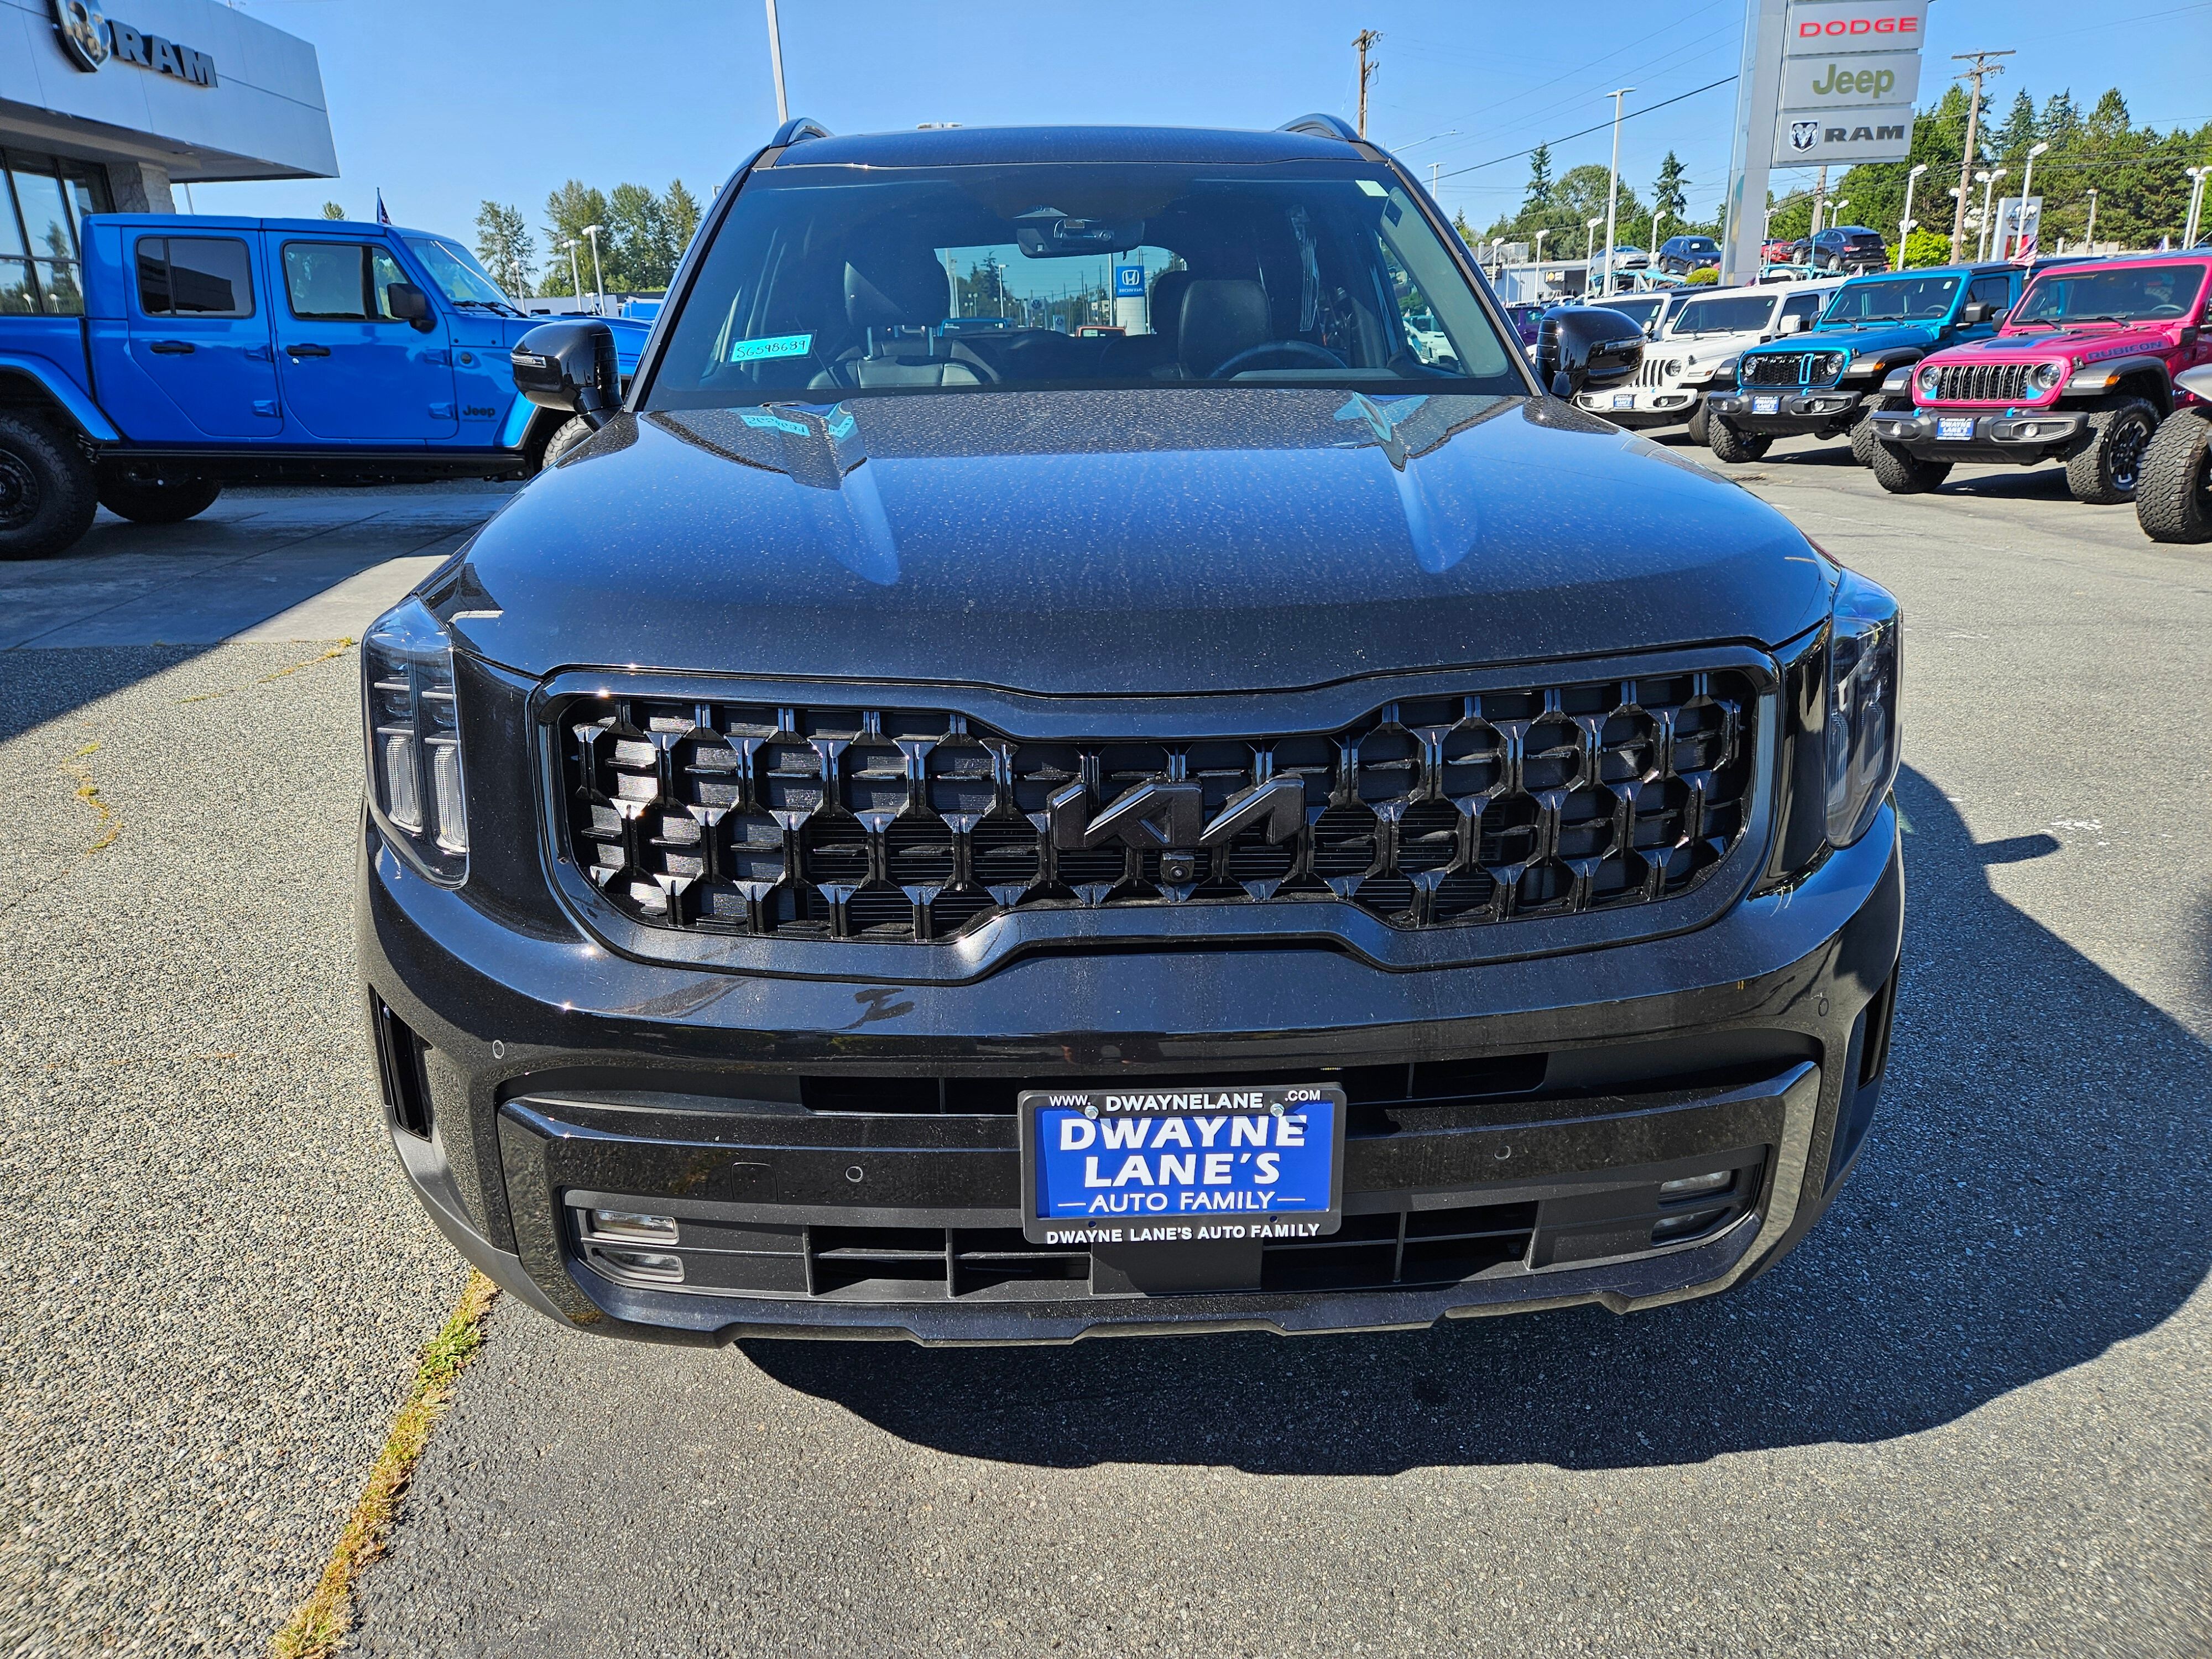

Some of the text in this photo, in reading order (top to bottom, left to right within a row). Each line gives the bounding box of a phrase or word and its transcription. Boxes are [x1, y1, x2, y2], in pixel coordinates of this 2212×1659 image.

[1799, 17, 1918, 38] DODGE
[109, 18, 218, 88] RAM
[1812, 64, 1895, 98] Jeep
[1824, 125, 1905, 143] RAM
[2087, 341, 2164, 361] RUBICON
[463, 405, 495, 418] Jeep
[1106, 1093, 1263, 1112] DWAYNELANE
[1285, 1090, 1321, 1102] .COM
[1060, 1115, 1307, 1151] DWAYNE
[1084, 1152, 1281, 1188] LANE'S
[1088, 1191, 1276, 1213] AUTO FAMILY
[1047, 1223, 1320, 1244] DWAYNE LANE'S AUTO FAMILY
